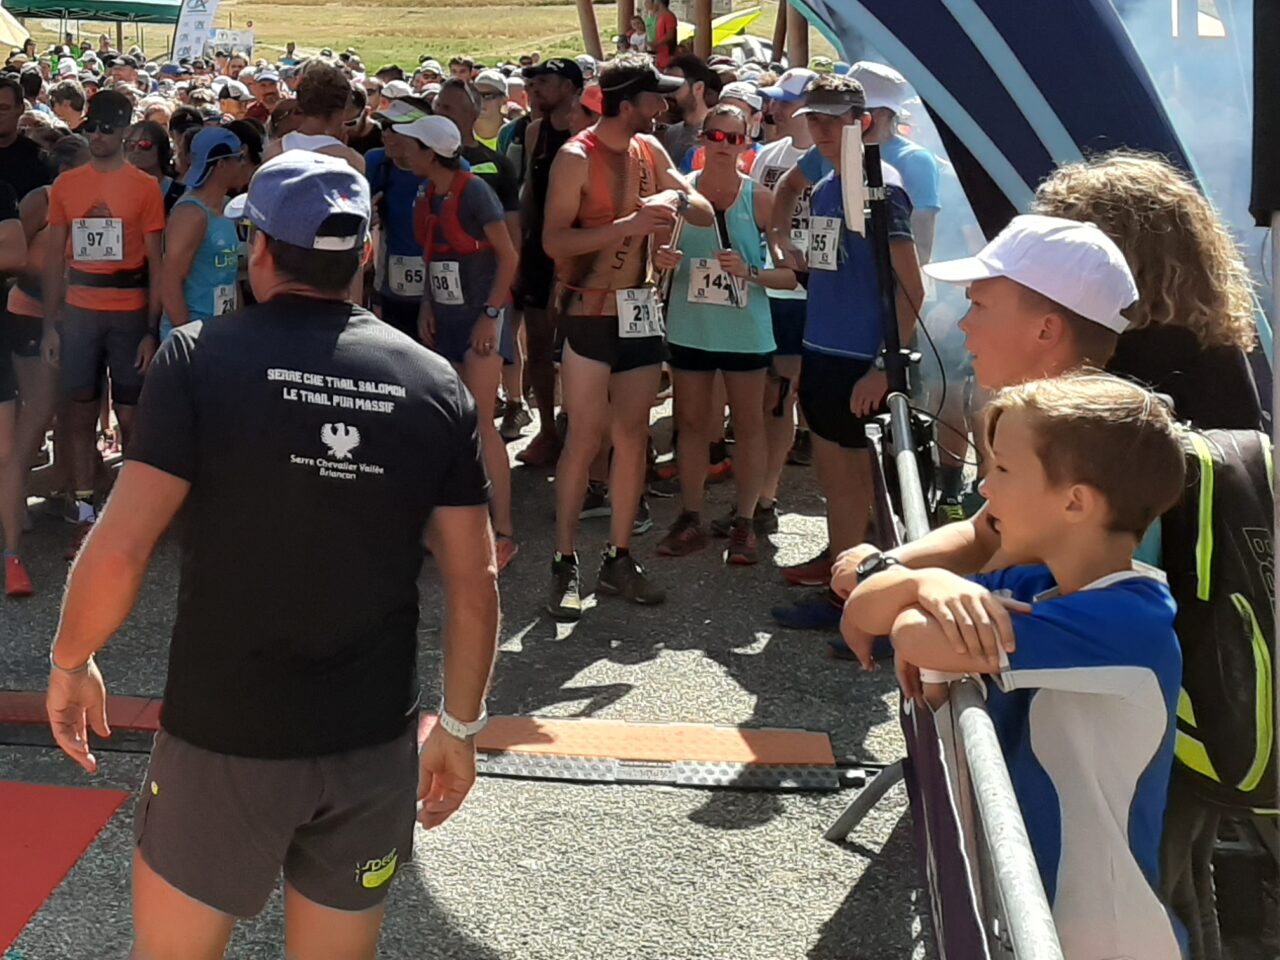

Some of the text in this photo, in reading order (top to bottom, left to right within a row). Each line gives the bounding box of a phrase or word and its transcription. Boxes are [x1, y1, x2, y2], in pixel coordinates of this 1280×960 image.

[87, 232, 104, 247] 97
[267, 368, 406, 398] SERRE CHE TRAIL SALOMON
[283, 387, 395, 414] LE TRAIL PUR MASSIF
